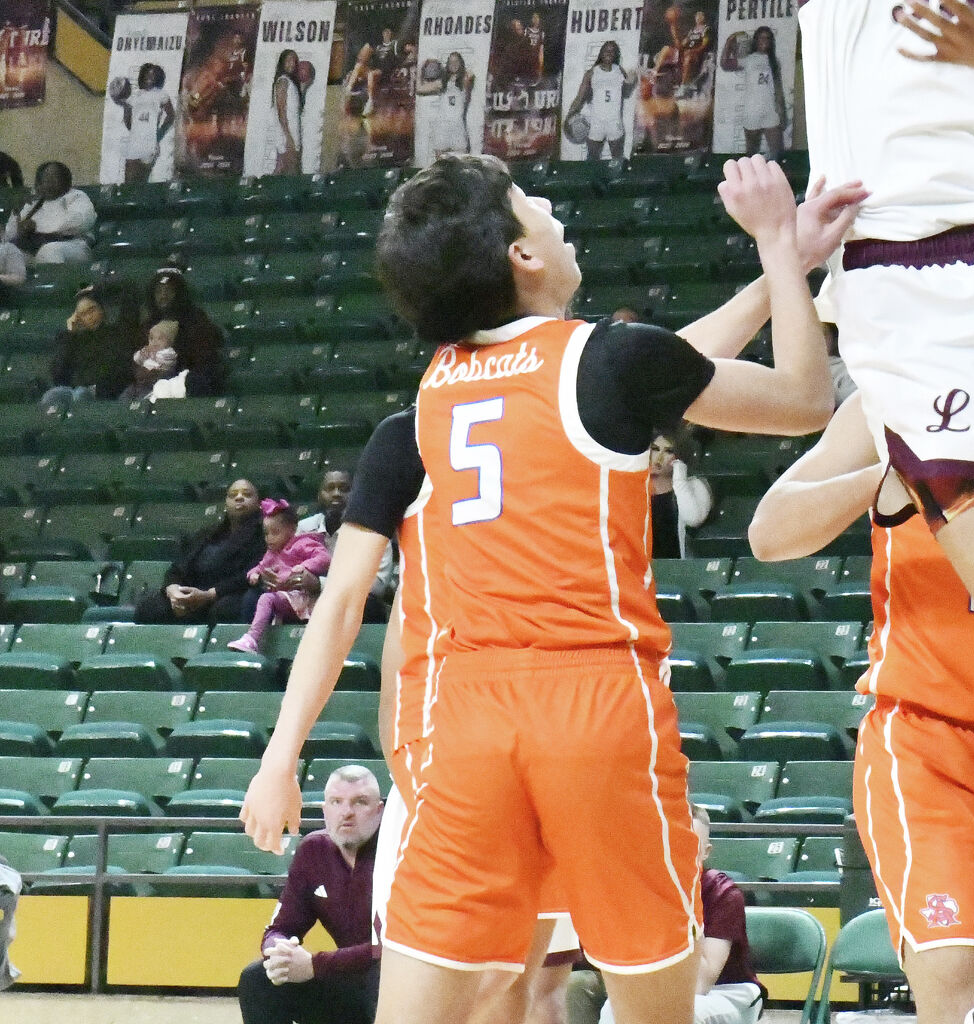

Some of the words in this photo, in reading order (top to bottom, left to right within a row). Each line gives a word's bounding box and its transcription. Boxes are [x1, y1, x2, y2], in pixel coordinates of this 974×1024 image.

[262, 20, 331, 43] WILSON
[423, 15, 492, 36] RHOADES
[570, 7, 644, 33] HUBERT
[604, 90, 611, 103] 5
[422, 342, 544, 389] Bobcats
[926, 388, 971, 433] L
[449, 396, 504, 527] 5
